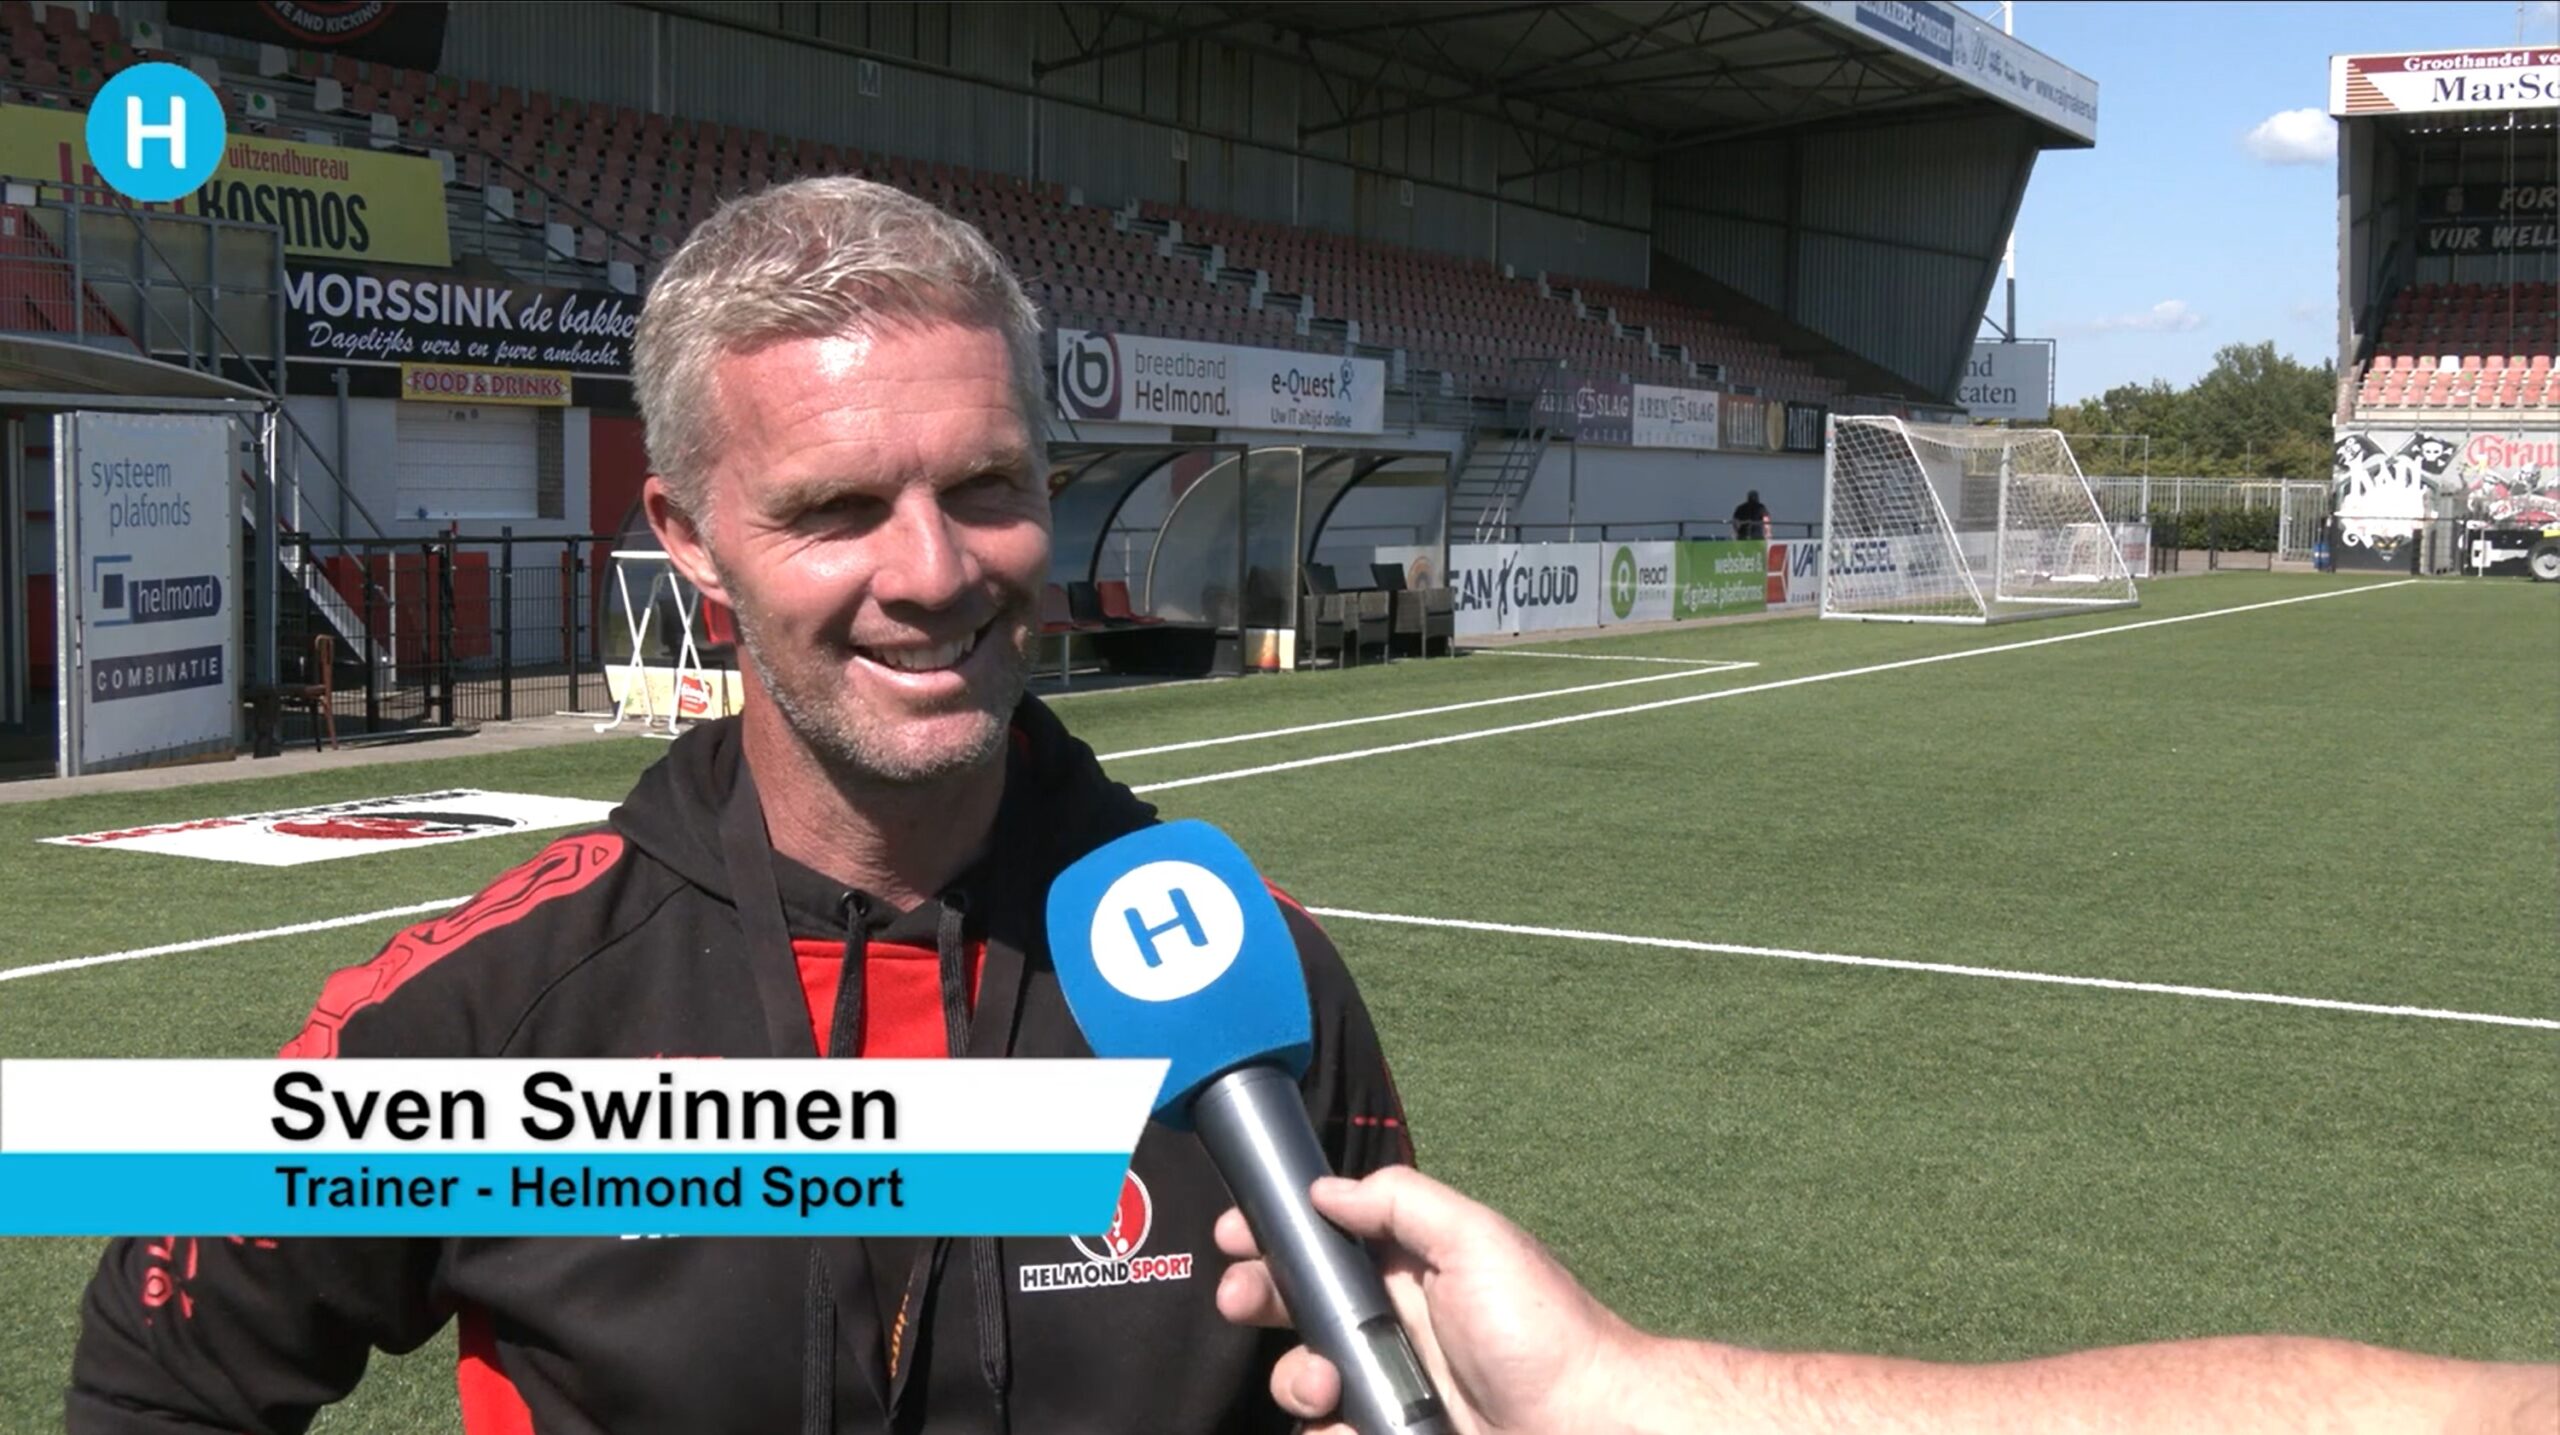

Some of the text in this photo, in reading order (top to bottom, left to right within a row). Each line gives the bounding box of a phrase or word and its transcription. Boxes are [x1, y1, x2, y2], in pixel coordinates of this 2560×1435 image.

[293, 8, 324, 31] AND
[325, 2, 383, 32] KICKING
[2403, 52, 2529, 71] Groothandel
[228, 143, 349, 181] uitzendbureau
[283, 270, 640, 350] MORSSINK de bakke
[308, 320, 621, 366] Dagelijks vers en pure ambacht.
[1135, 349, 1227, 381] breedband
[411, 370, 562, 397] FOOD & DRINKS
[1135, 380, 1231, 416] Helmond.
[1271, 367, 1336, 403] e-Quest
[1323, 411, 1352, 429] online
[91, 457, 172, 496] systeem
[110, 493, 192, 536] plafonds
[1514, 565, 1578, 608] CLOUD
[1639, 564, 1668, 585] react
[137, 576, 214, 615] helmond
[96, 657, 219, 692] COMBINATIE
[1123, 887, 1209, 968] H
